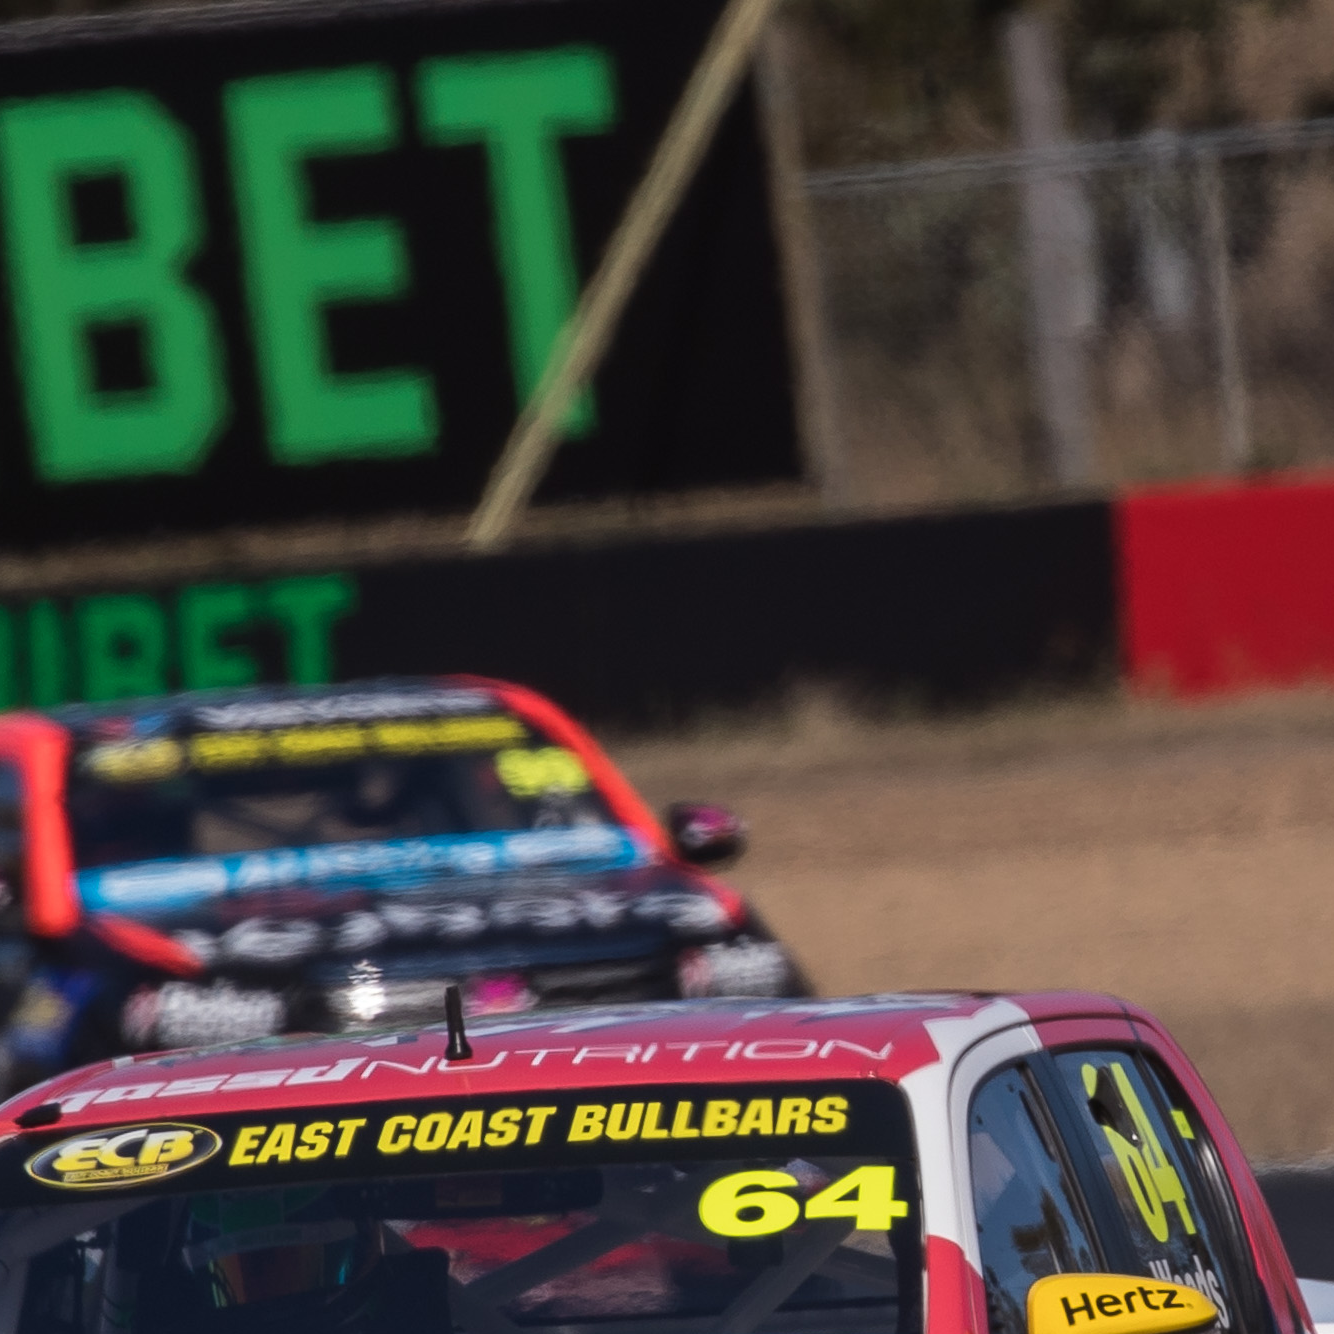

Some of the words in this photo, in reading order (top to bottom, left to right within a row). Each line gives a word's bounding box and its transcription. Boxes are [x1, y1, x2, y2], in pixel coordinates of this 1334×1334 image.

[53, 1129, 194, 1171] ECB
[229, 1118, 367, 1166] EAST
[377, 1106, 557, 1154] COAST
[567, 1096, 848, 1142] BULLBARS
[699, 1165, 908, 1237] 64
[1060, 1285, 1185, 1325] Hertz
